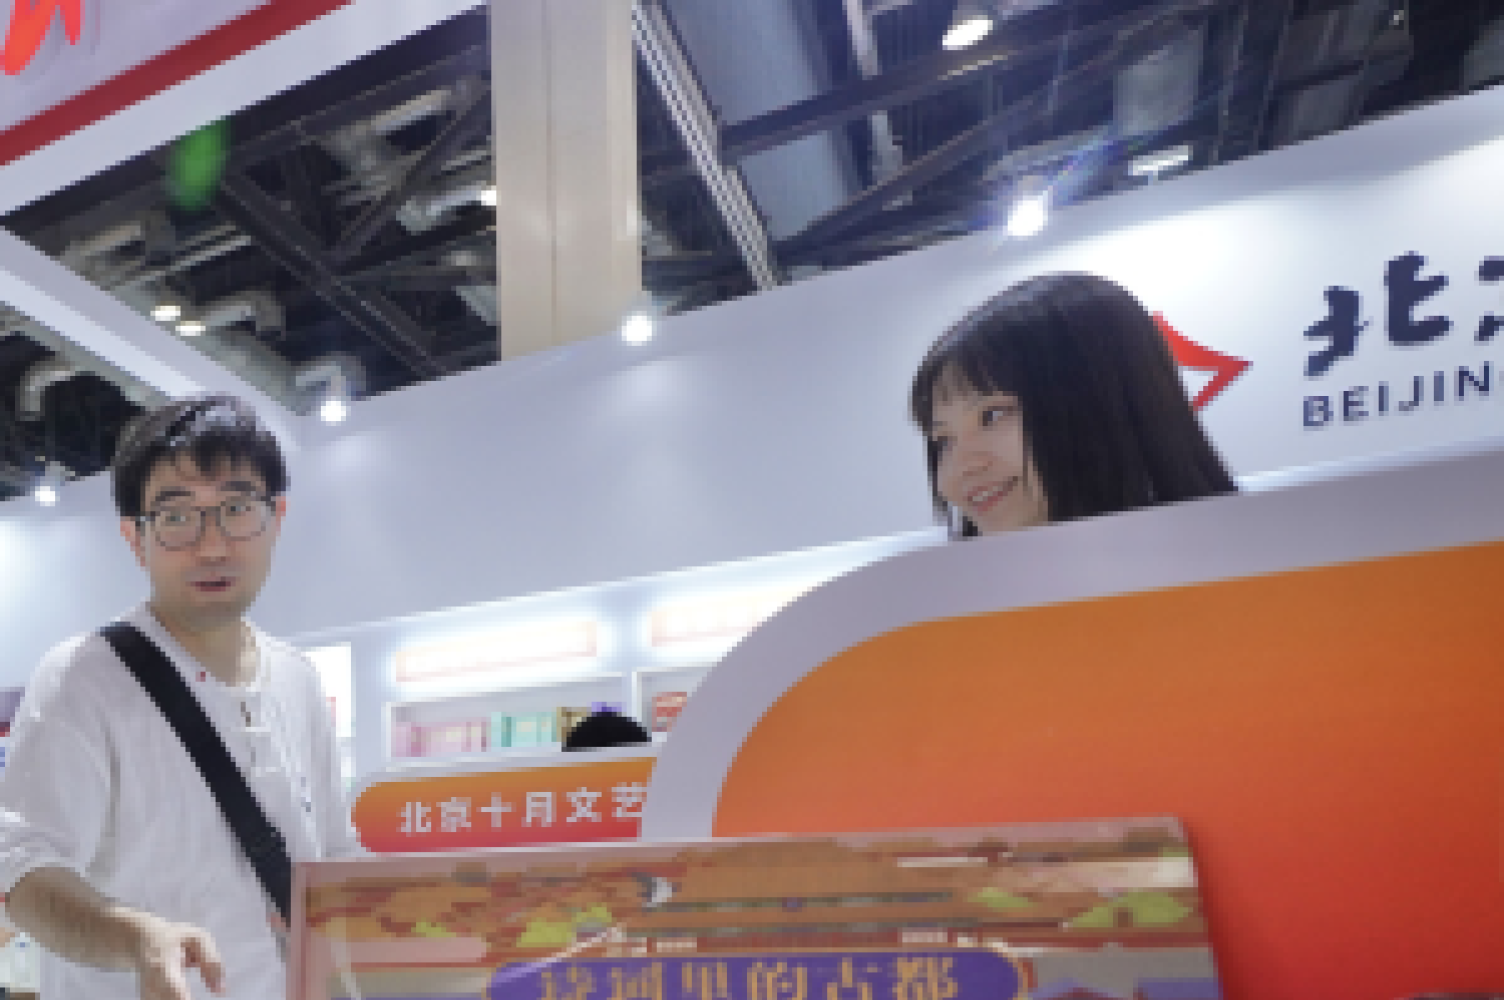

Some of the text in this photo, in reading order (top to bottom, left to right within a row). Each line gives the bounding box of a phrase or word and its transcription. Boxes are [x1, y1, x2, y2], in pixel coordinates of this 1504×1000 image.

[1302, 250, 1504, 378] 北
[1303, 361, 1504, 428] BEIJIN
[400, 780, 648, 838] 北京十月文艺
